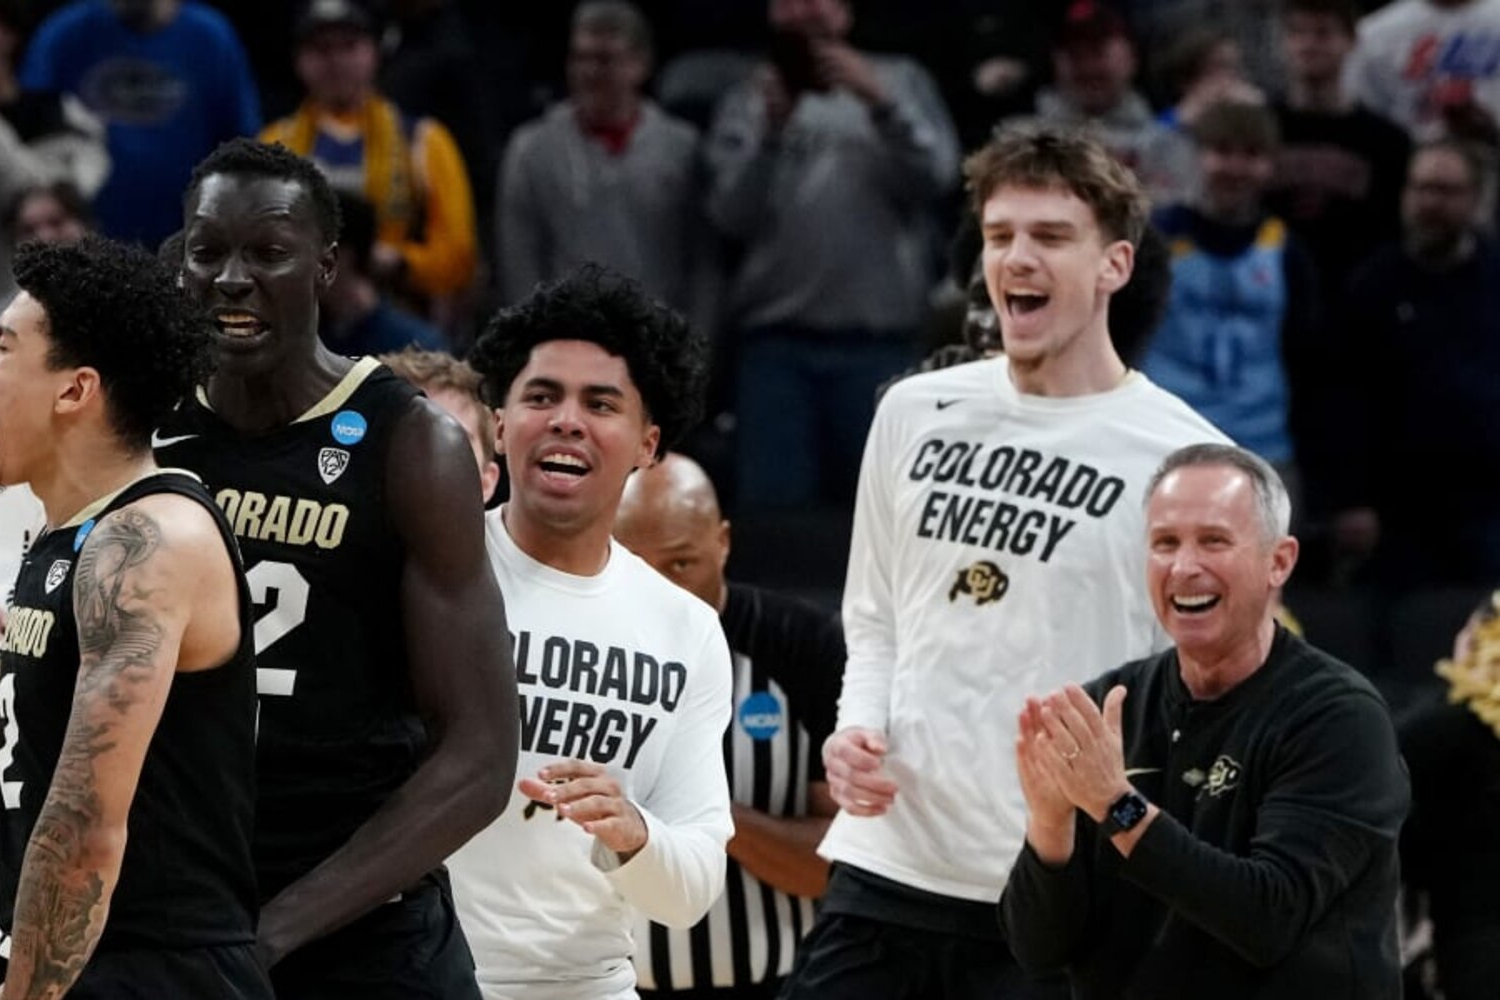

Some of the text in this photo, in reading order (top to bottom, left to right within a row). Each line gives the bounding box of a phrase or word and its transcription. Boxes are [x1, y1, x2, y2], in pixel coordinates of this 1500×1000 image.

[908, 438, 1126, 519] COLORADO
[916, 490, 1077, 563] ENERGY
[509, 630, 688, 714] LORADO
